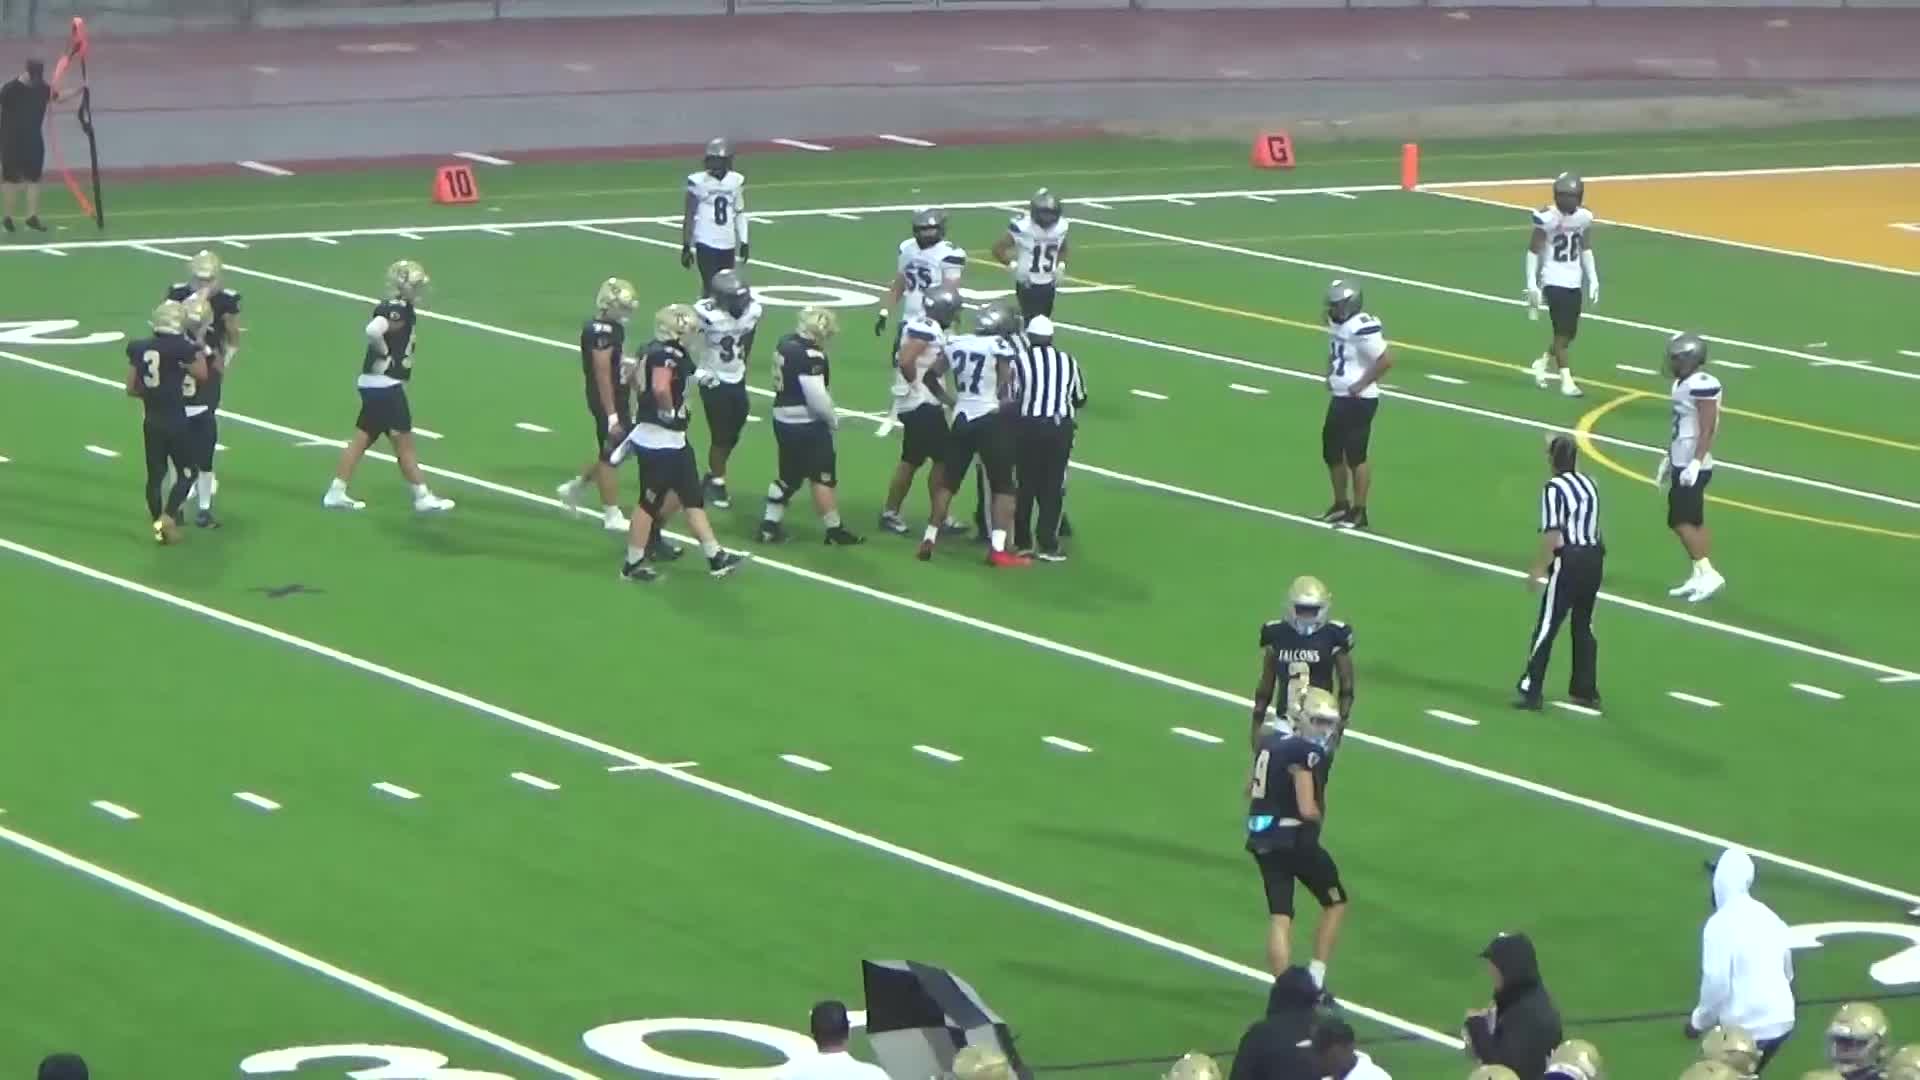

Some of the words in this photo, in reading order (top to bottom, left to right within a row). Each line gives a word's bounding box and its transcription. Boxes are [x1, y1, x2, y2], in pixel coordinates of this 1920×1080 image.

[1267, 136, 1288, 163] G
[445, 170, 472, 198] 10
[714, 195, 728, 226] 8
[1029, 244, 1058, 273] 15
[143, 349, 160, 388] 3
[952, 349, 986, 395] 27
[1279, 649, 1321, 663] FALCONS
